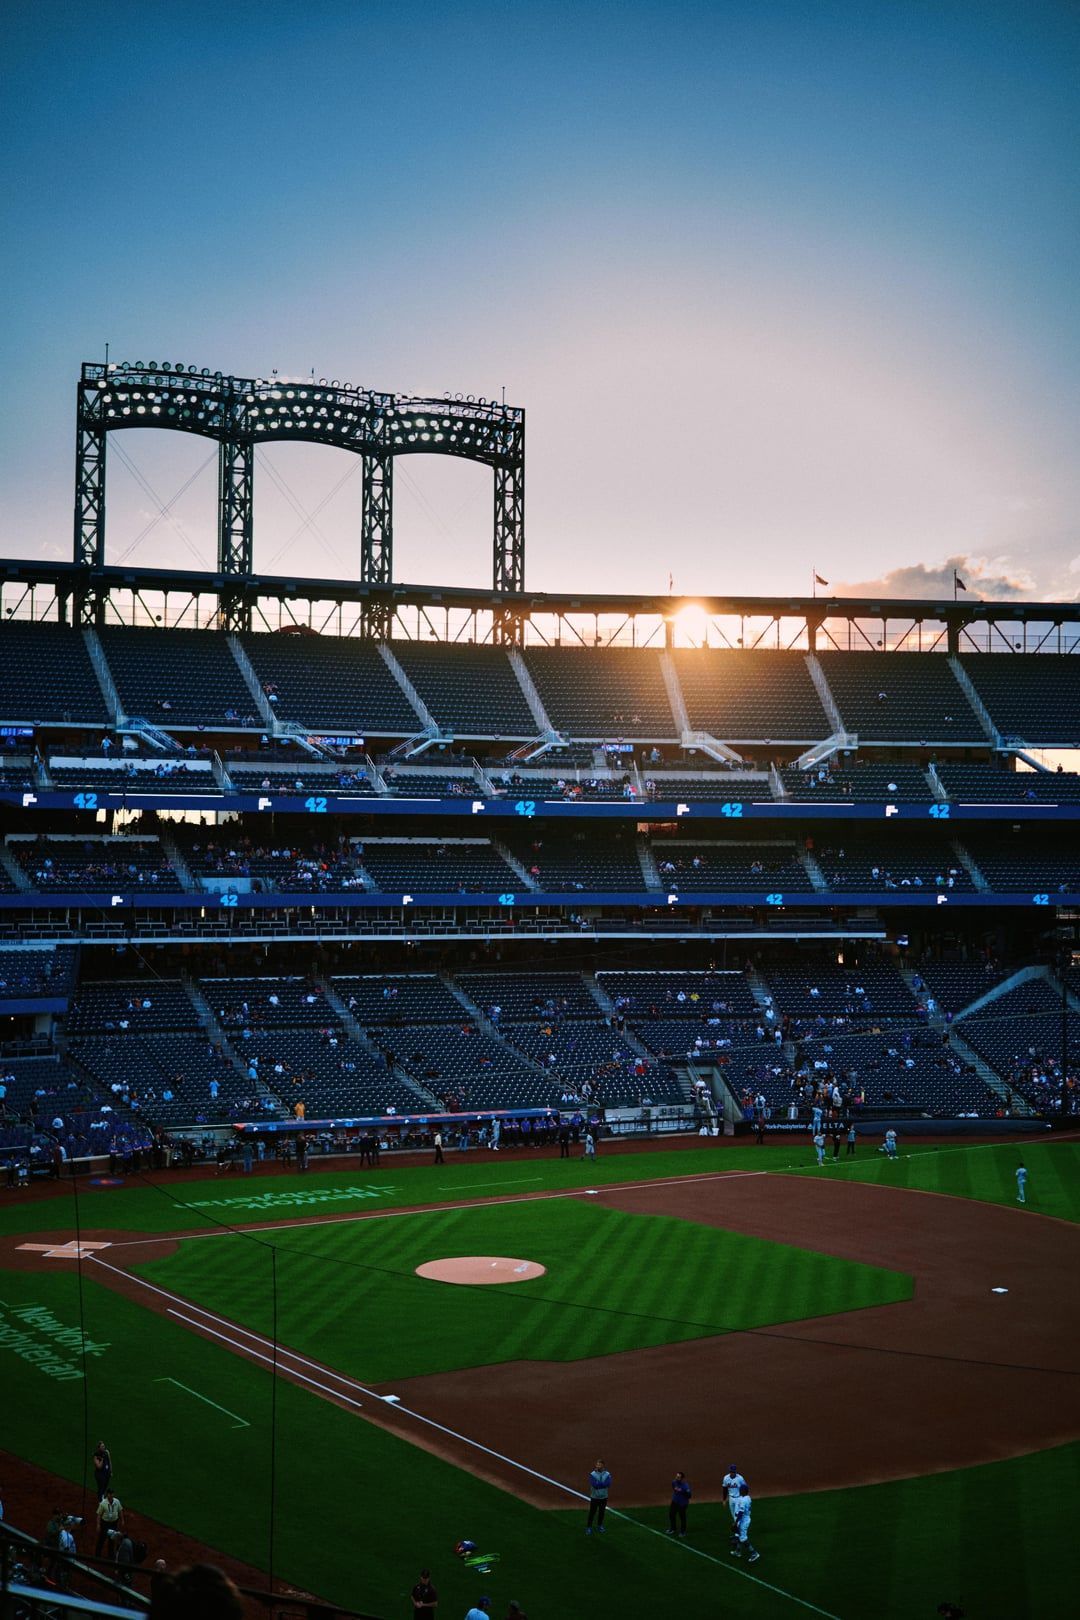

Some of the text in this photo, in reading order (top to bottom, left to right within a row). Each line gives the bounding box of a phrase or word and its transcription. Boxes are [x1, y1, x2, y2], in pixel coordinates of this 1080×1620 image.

[73, 792, 97, 809] 42
[304, 797, 327, 813] 42
[514, 800, 536, 817] 42
[720, 802, 743, 818] 42
[927, 804, 950, 819] 42
[220, 894, 239, 908] 42
[498, 894, 515, 906] 42
[765, 893, 783, 906] 42
[1032, 893, 1050, 905] 42
